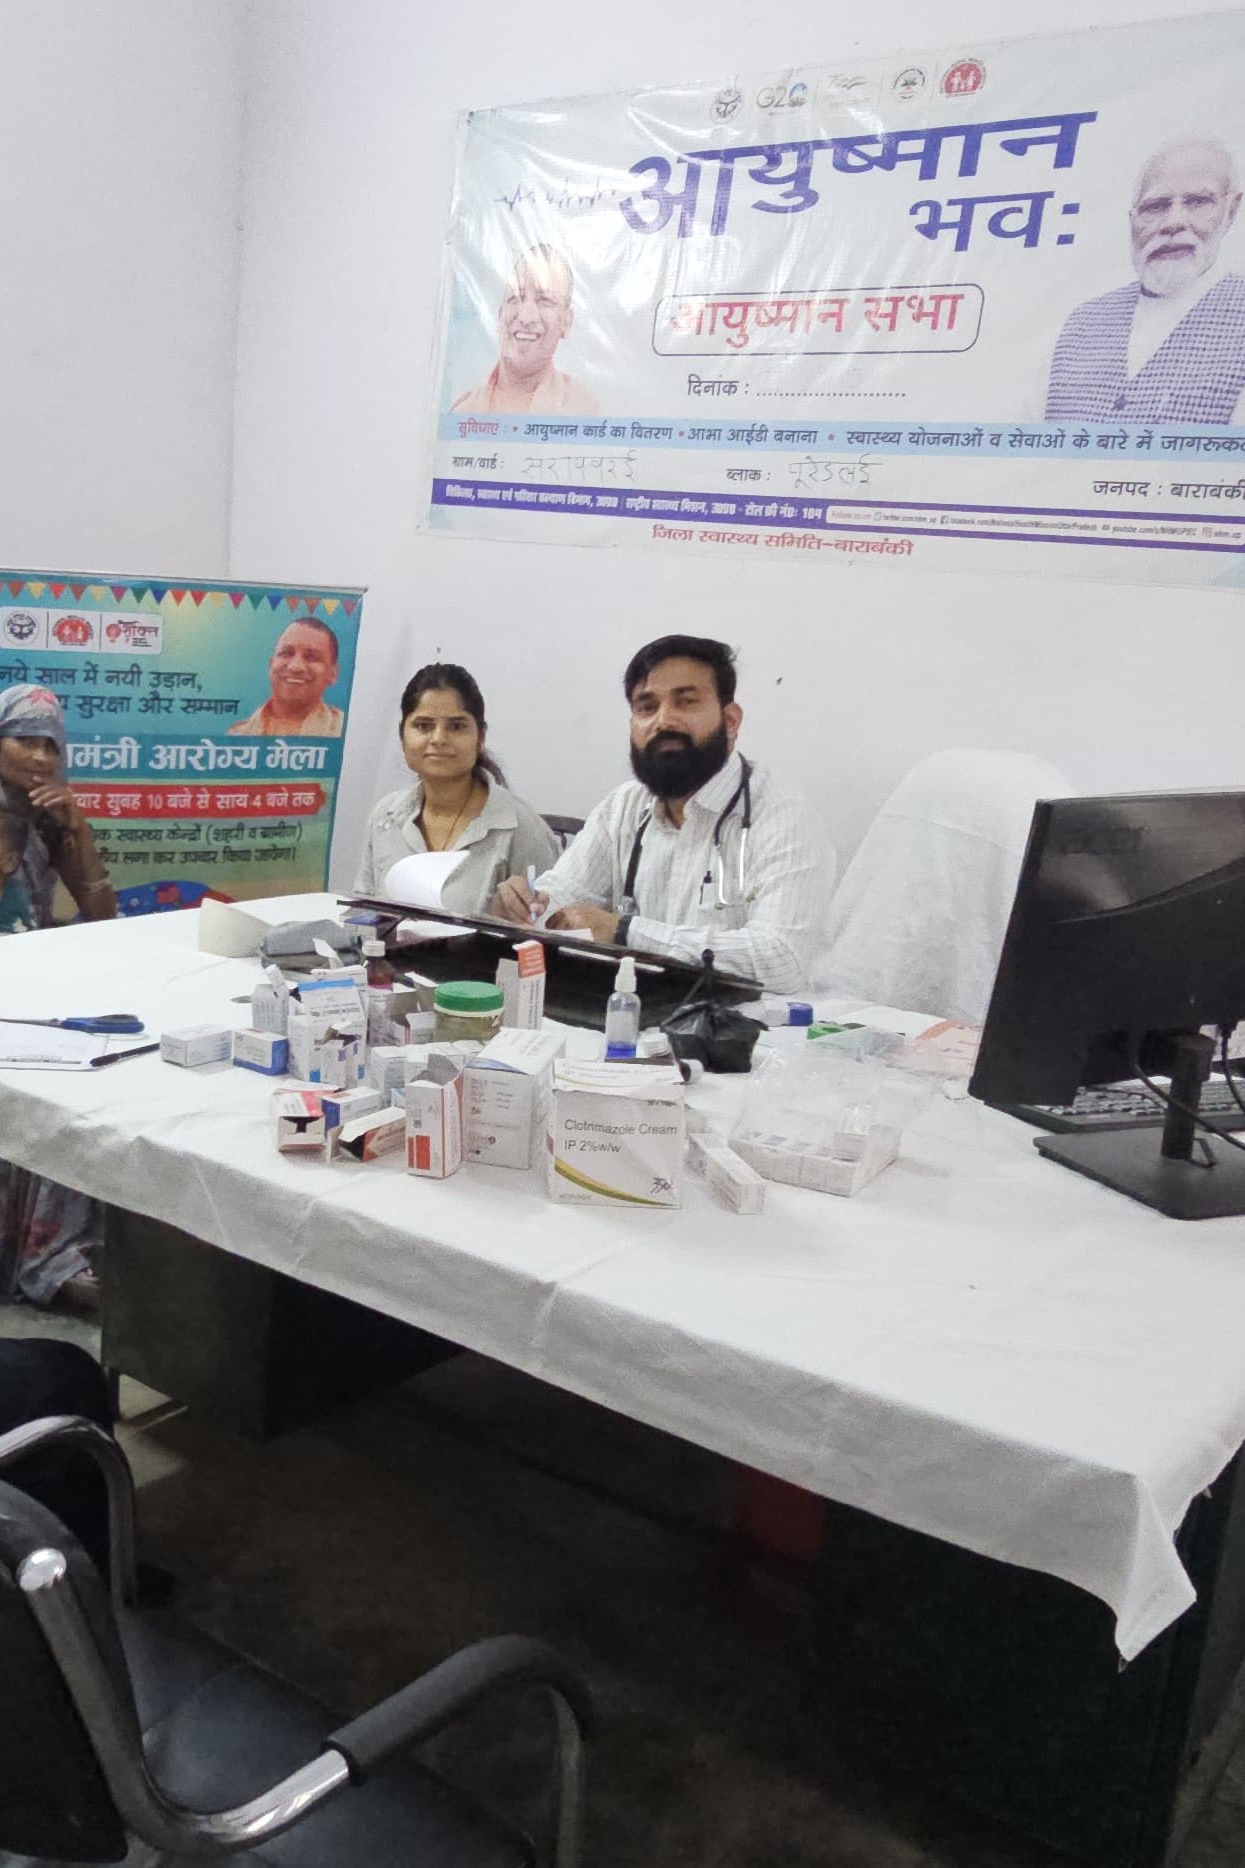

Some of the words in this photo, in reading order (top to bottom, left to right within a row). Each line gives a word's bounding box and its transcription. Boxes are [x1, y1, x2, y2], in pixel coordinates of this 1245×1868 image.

[619, 111, 1098, 239] आयुष्मान
[669, 297, 850, 349] आयुष्मान
[864, 293, 966, 332] सभा
[687, 372, 739, 397] दिनांक
[523, 424, 578, 443] आयुष्मान
[582, 420, 606, 440] कार्ड
[610, 424, 627, 440] का
[630, 421, 673, 442] वितरण
[687, 425, 722, 442] आभा
[726, 422, 768, 445] आईडी
[773, 429, 818, 445] बनाना
[846, 429, 901, 447] स्वास्थ्य
[908, 427, 984, 448] योजनाओं
[988, 432, 1001, 447] व
[1008, 427, 1066, 449] सेवाओं
[1072, 428, 1090, 449] के
[1097, 428, 1128, 450] बारे
[1135, 428, 1154, 451] में
[726, 466, 763, 483] ब्लाक
[1093, 480, 1150, 498] जनपद
[652, 523, 692, 541] जिला
[699, 528, 759, 546] स्वास्थ्य
[35, 665, 76, 686] साल
[82, 661, 99, 688] में
[105, 665, 141, 689] नयी
[148, 669, 203, 693] उड़ान,
[74, 695, 131, 719] सुरक्षा
[137, 690, 176, 715] और
[181, 698, 240, 716] सम्मान
[65, 735, 141, 772] मंत्री
[148, 738, 258, 772] आरोग्य
[265, 738, 328, 770] मेला
[73, 792, 102, 810] वार
[106, 792, 142, 816] सुबह
[147, 794, 163, 811] 10
[167, 788, 192, 810] बजे
[196, 788, 210, 810] से
[253, 794, 261, 808] 4
[265, 789, 289, 808] बजे
[292, 791, 316, 808] तक
[117, 828, 162, 842] स्वास्थ्य
[564, 1119, 635, 1135] Clotrimazole
[638, 1123, 677, 1135] Cream
[564, 1139, 576, 1151] IP
